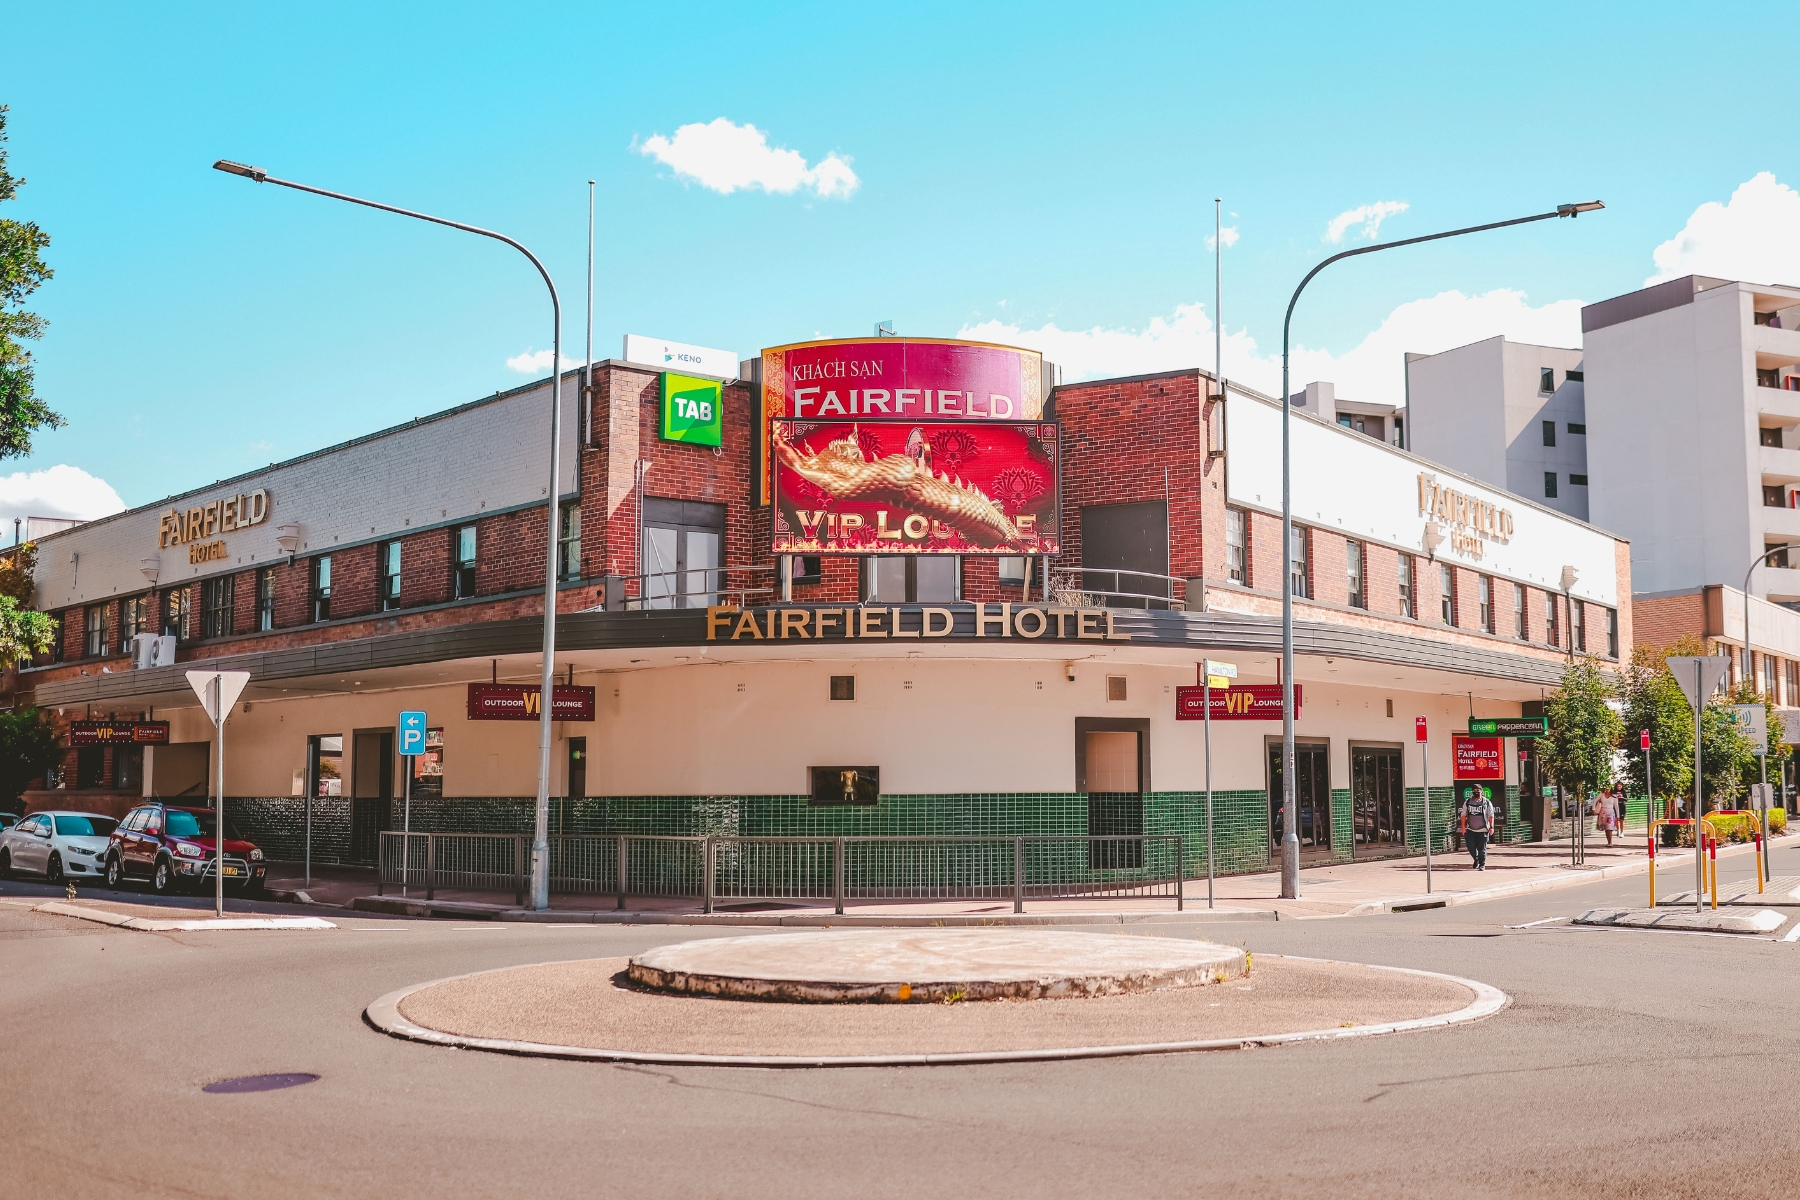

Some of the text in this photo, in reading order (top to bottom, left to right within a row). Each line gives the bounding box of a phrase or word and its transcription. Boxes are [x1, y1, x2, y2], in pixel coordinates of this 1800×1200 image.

[677, 353, 702, 364] KENO
[792, 359, 883, 381] KHÁCH SẠN
[674, 397, 712, 421] TAB
[793, 386, 1014, 418] FAIRFIELD
[1418, 471, 1514, 541] FAIRFIELD
[158, 488, 269, 549] FAIRFIELD
[796, 510, 1038, 540] VIP LOUE
[189, 540, 228, 564] HOTEL
[706, 602, 1132, 640] FAIRFIELD HOTEL
[523, 693, 540, 713] VI
[1225, 692, 1254, 713] VIP
[96, 728, 113, 739] VIP
[404, 730, 421, 750] P
[1457, 749, 1498, 758] FAIRFIELD
